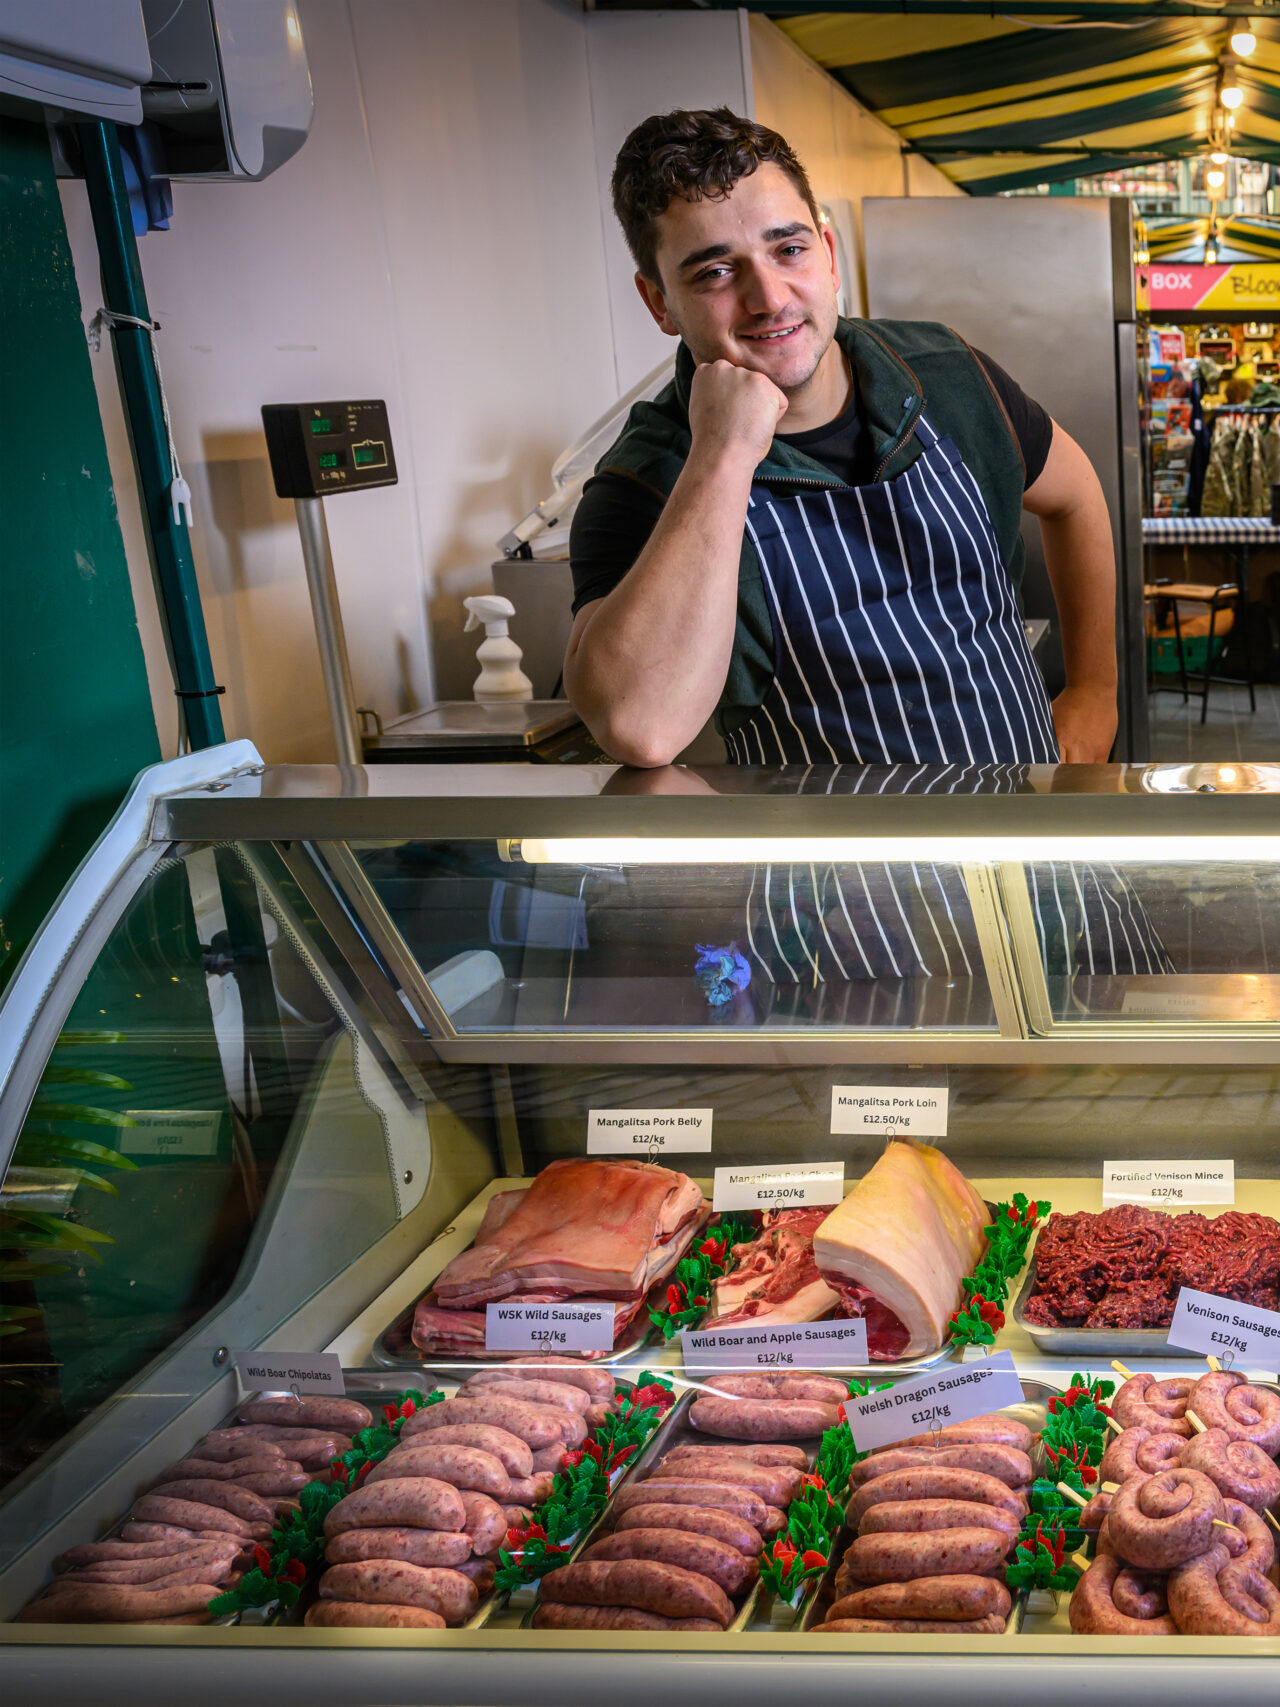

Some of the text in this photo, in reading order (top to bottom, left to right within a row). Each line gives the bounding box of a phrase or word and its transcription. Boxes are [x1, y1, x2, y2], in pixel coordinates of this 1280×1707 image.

[1151, 273, 1192, 290] BOX
[838, 1097, 937, 1108] Mangalitsa Pork Loin
[597, 1117, 702, 1128] Mangalitsa Pork Belly
[864, 1114, 910, 1126] £12.50/kg
[632, 1134, 665, 1144] £12/kg
[1111, 1172, 1224, 1181] Fortified Venison Mince
[757, 1188, 804, 1199] £12.50/kg
[1152, 1188, 1183, 1198] £12/kg
[498, 1310, 602, 1322] WSK Wild Sausages
[1186, 1302, 1230, 1323] Venison
[531, 1330, 566, 1342] £12/kg
[692, 1328, 856, 1348] Wild Boar and Apple Sausages
[1210, 1331, 1248, 1352] £12/kg
[757, 1352, 794, 1363] £12/kg
[247, 1368, 332, 1381] Wild Boar Chipolatas
[858, 1368, 994, 1416] Welsh Dragon Sausages
[912, 1404, 951, 1424] £12/kg
